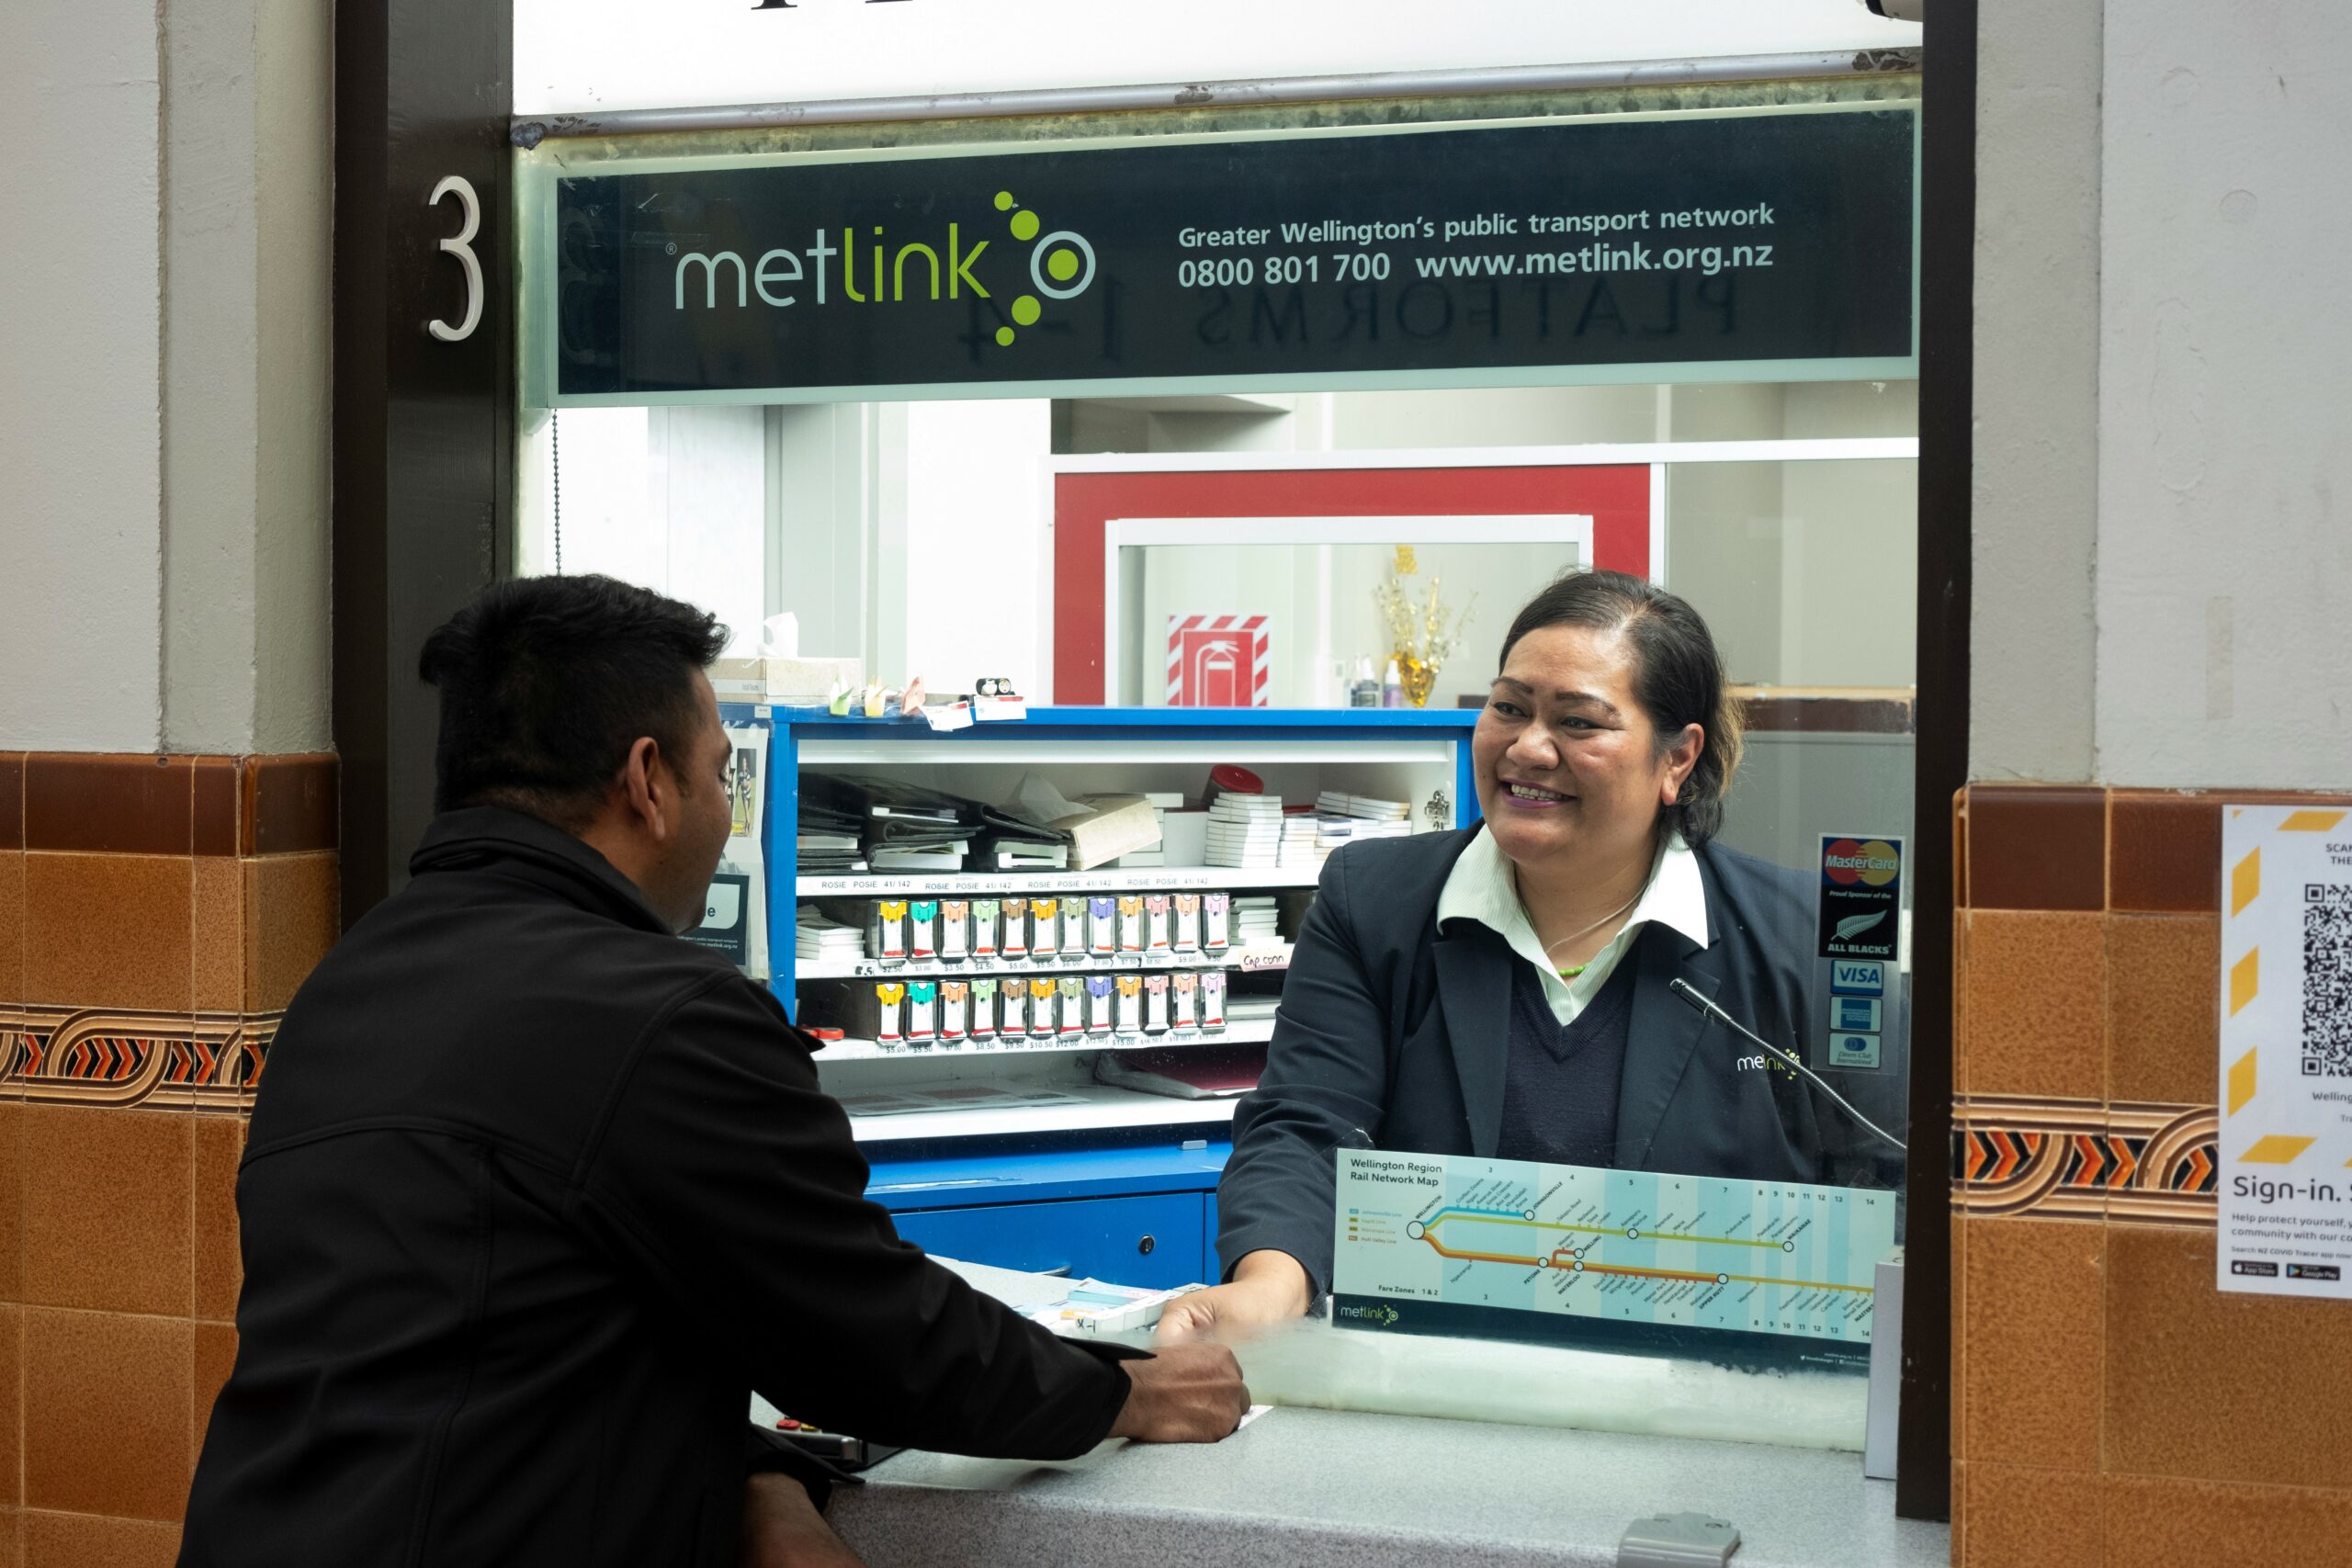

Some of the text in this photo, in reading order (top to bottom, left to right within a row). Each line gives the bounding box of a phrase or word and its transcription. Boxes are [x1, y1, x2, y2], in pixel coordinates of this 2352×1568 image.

[1179, 202, 1775, 249] Greater Wellington's public transport network
[428, 175, 484, 342] 3
[1178, 243, 1774, 288] 0800 801 700 www.metlink.org.nz
[674, 223, 991, 310] metlink
[1825, 854, 1896, 870] MasterCard
[2330, 856, 2352, 864] THE
[821, 881, 846, 889] ROSIE
[1848, 891, 1871, 899] Sponsor
[707, 907, 716, 917] e
[1827, 943, 1889, 954] ALL BLACKS
[976, 963, 994, 971] $4.50
[1243, 954, 1261, 966] Cap
[1838, 966, 1880, 984] VISA
[886, 1045, 906, 1054] $5.00
[1351, 1158, 1442, 1174] Wellington Region
[1351, 1172, 1439, 1187] Rail Network Map
[2233, 1175, 2341, 1204] Sign-in.
[1415, 1195, 1442, 1220] WELLINGTON
[2232, 1213, 2346, 1228] Help protect yourself,
[2231, 1228, 2291, 1240] community
[2293, 1231, 2316, 1240] with
[1395, 1286, 1415, 1294] Zones
[1558, 1274, 1580, 1294] WATERLOO
[1699, 1287, 1724, 1310] UPPER HUTT
[1340, 1305, 1384, 1319] metlink
